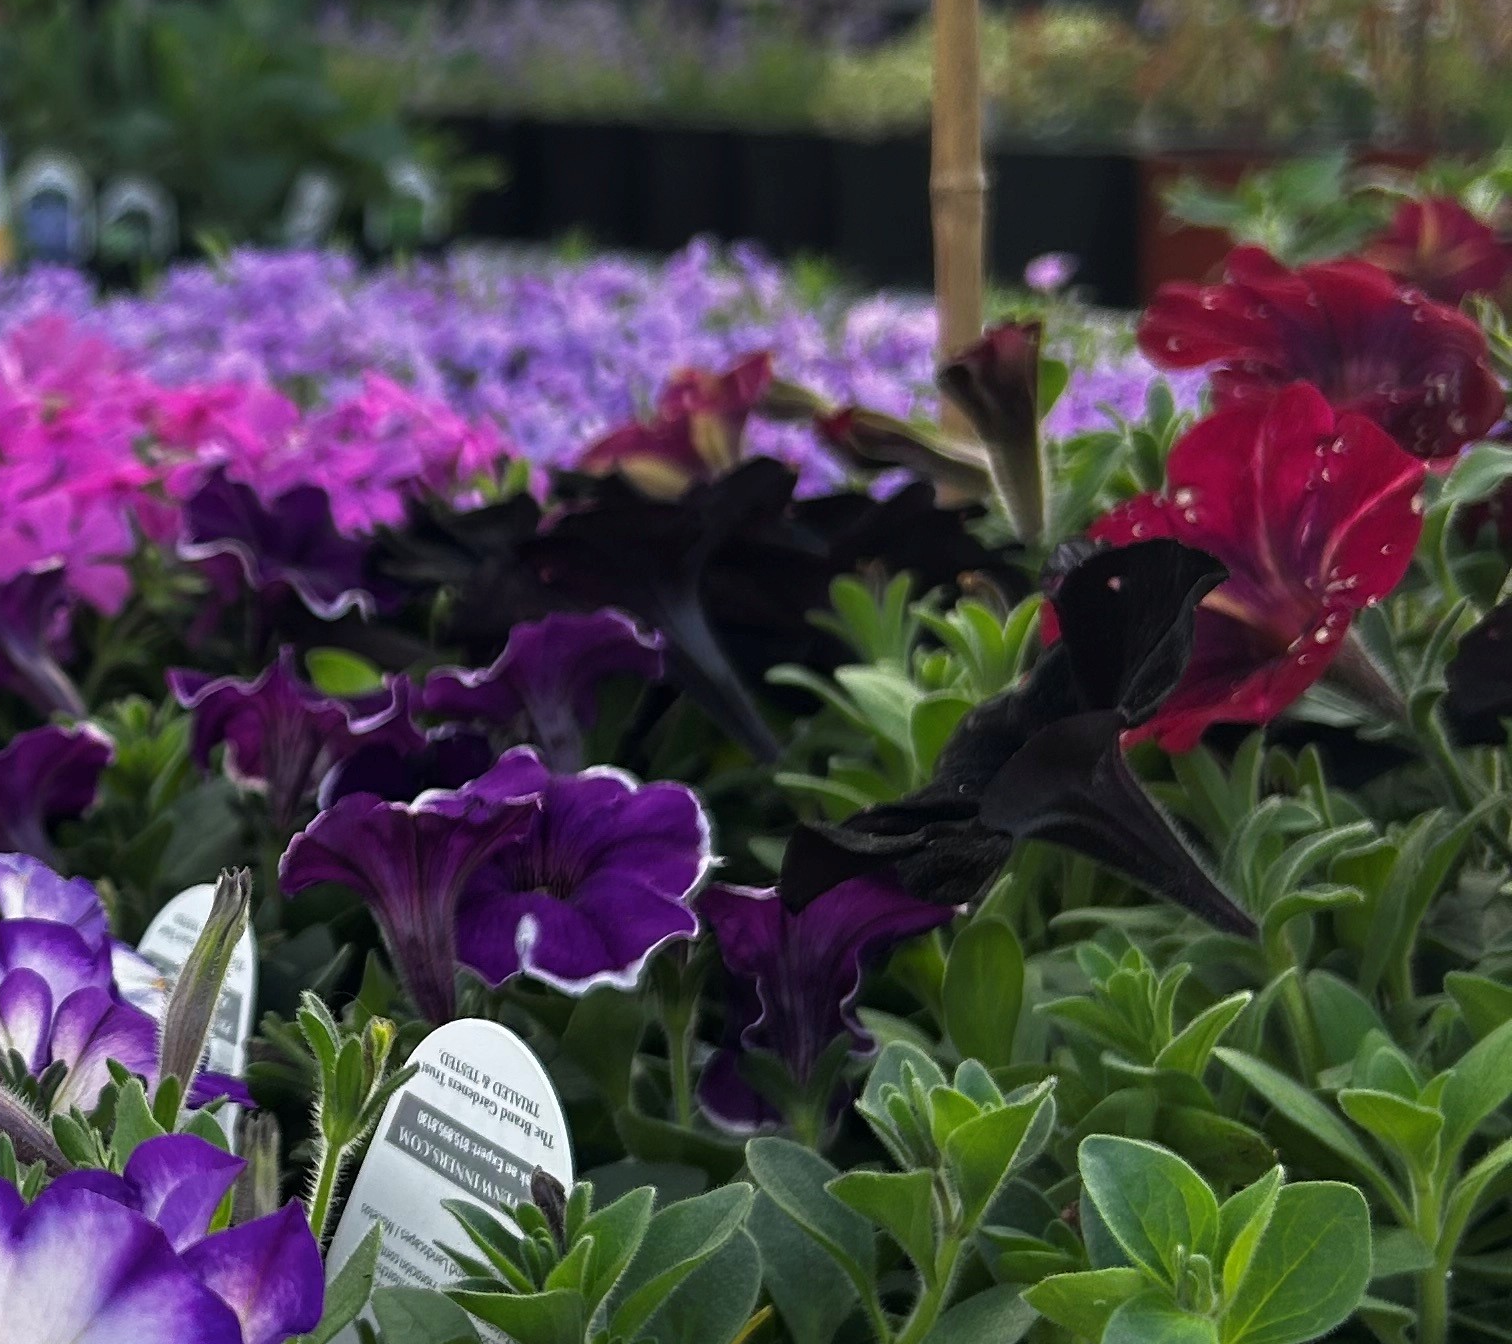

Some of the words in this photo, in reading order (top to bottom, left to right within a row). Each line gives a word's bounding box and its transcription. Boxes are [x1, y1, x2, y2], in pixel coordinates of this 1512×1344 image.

[420, 1061, 446, 1088] Trust
[447, 1079, 498, 1116] Gardeners
[493, 1081, 540, 1118] TRIALED
[499, 1108, 533, 1136] Brand
[534, 1130, 555, 1150] The
